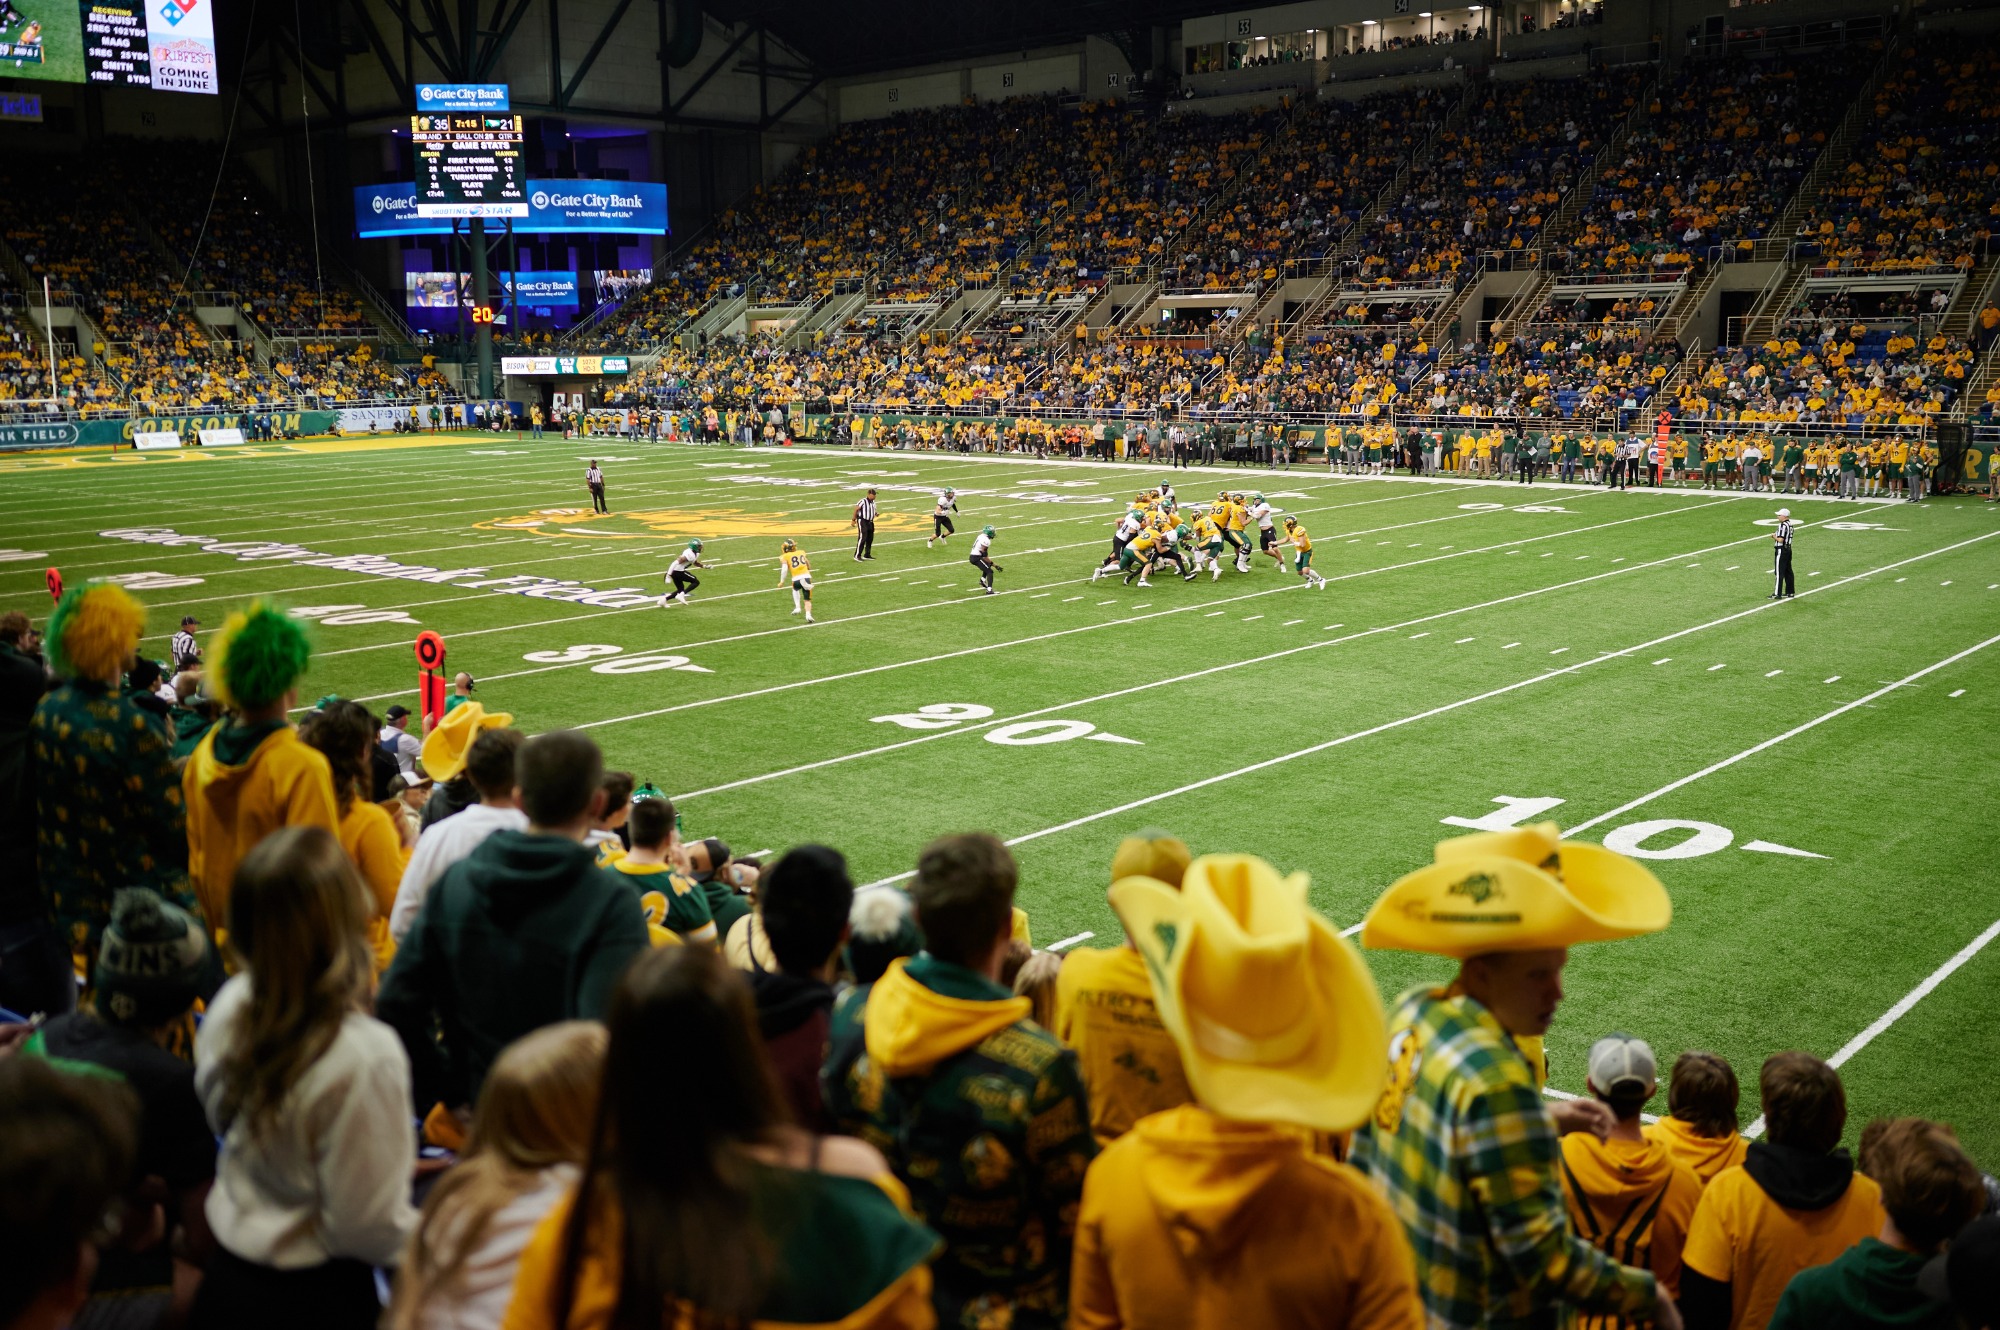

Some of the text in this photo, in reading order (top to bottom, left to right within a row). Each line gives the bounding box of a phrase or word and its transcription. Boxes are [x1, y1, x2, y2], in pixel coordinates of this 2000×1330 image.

[92, 6, 132, 16] RECEIVING
[89, 12, 138, 26] BELQUIST
[1238, 18, 1250, 34] 33
[101, 36, 130, 48] MAAG
[165, 48, 213, 63] RIBFEST
[102, 60, 134, 71] SMITH
[159, 67, 209, 79] COMING
[161, 77, 209, 89] IN JUNE
[1004, 73, 1013, 87] 31
[1108, 73, 1118, 87] 32
[434, 88, 504, 101] Gate City Bank
[435, 119, 448, 130] 35
[455, 119, 477, 128] 7:15
[500, 120, 513, 130] 21
[384, 197, 407, 210] Gate
[551, 193, 642, 210] Gate City Bank
[486, 206, 513, 214] STAR
[517, 281, 574, 292] Gate City Bank
[472, 307, 492, 323] 20
[351, 408, 411, 421] SANFORD
[23, 429, 67, 441] FIELD
[97, 528, 674, 608] Gate City Bank Field
[522, 644, 690, 674] 30
[868, 703, 1096, 745] 20
[1439, 795, 1735, 860] 10
